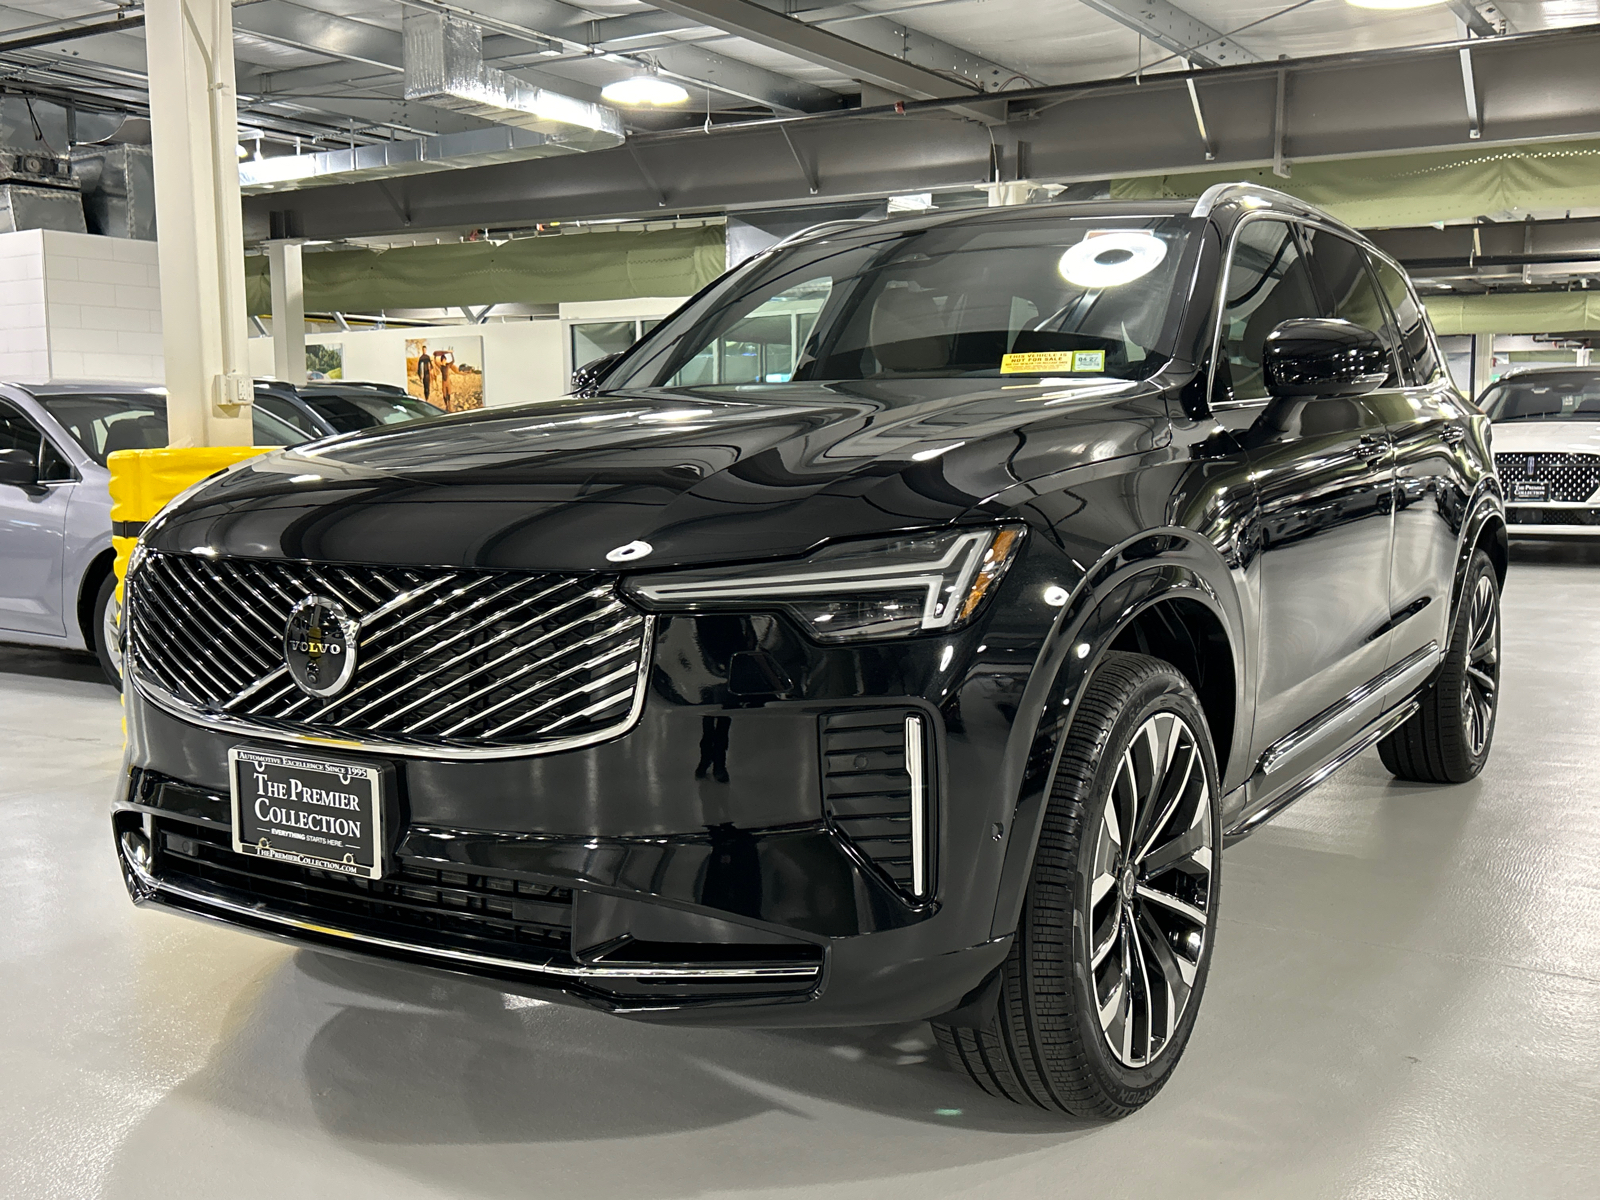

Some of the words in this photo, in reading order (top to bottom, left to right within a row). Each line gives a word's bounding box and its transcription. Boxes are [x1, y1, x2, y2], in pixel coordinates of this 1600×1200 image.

[289, 640, 341, 654] VOLVO
[347, 767, 367, 777] 1995
[253, 772, 287, 800] THE
[289, 778, 361, 812] PREMIER
[254, 797, 361, 839] COLLECTION
[271, 828, 305, 840] EVERYTHING
[306, 835, 326, 844] STARTS
